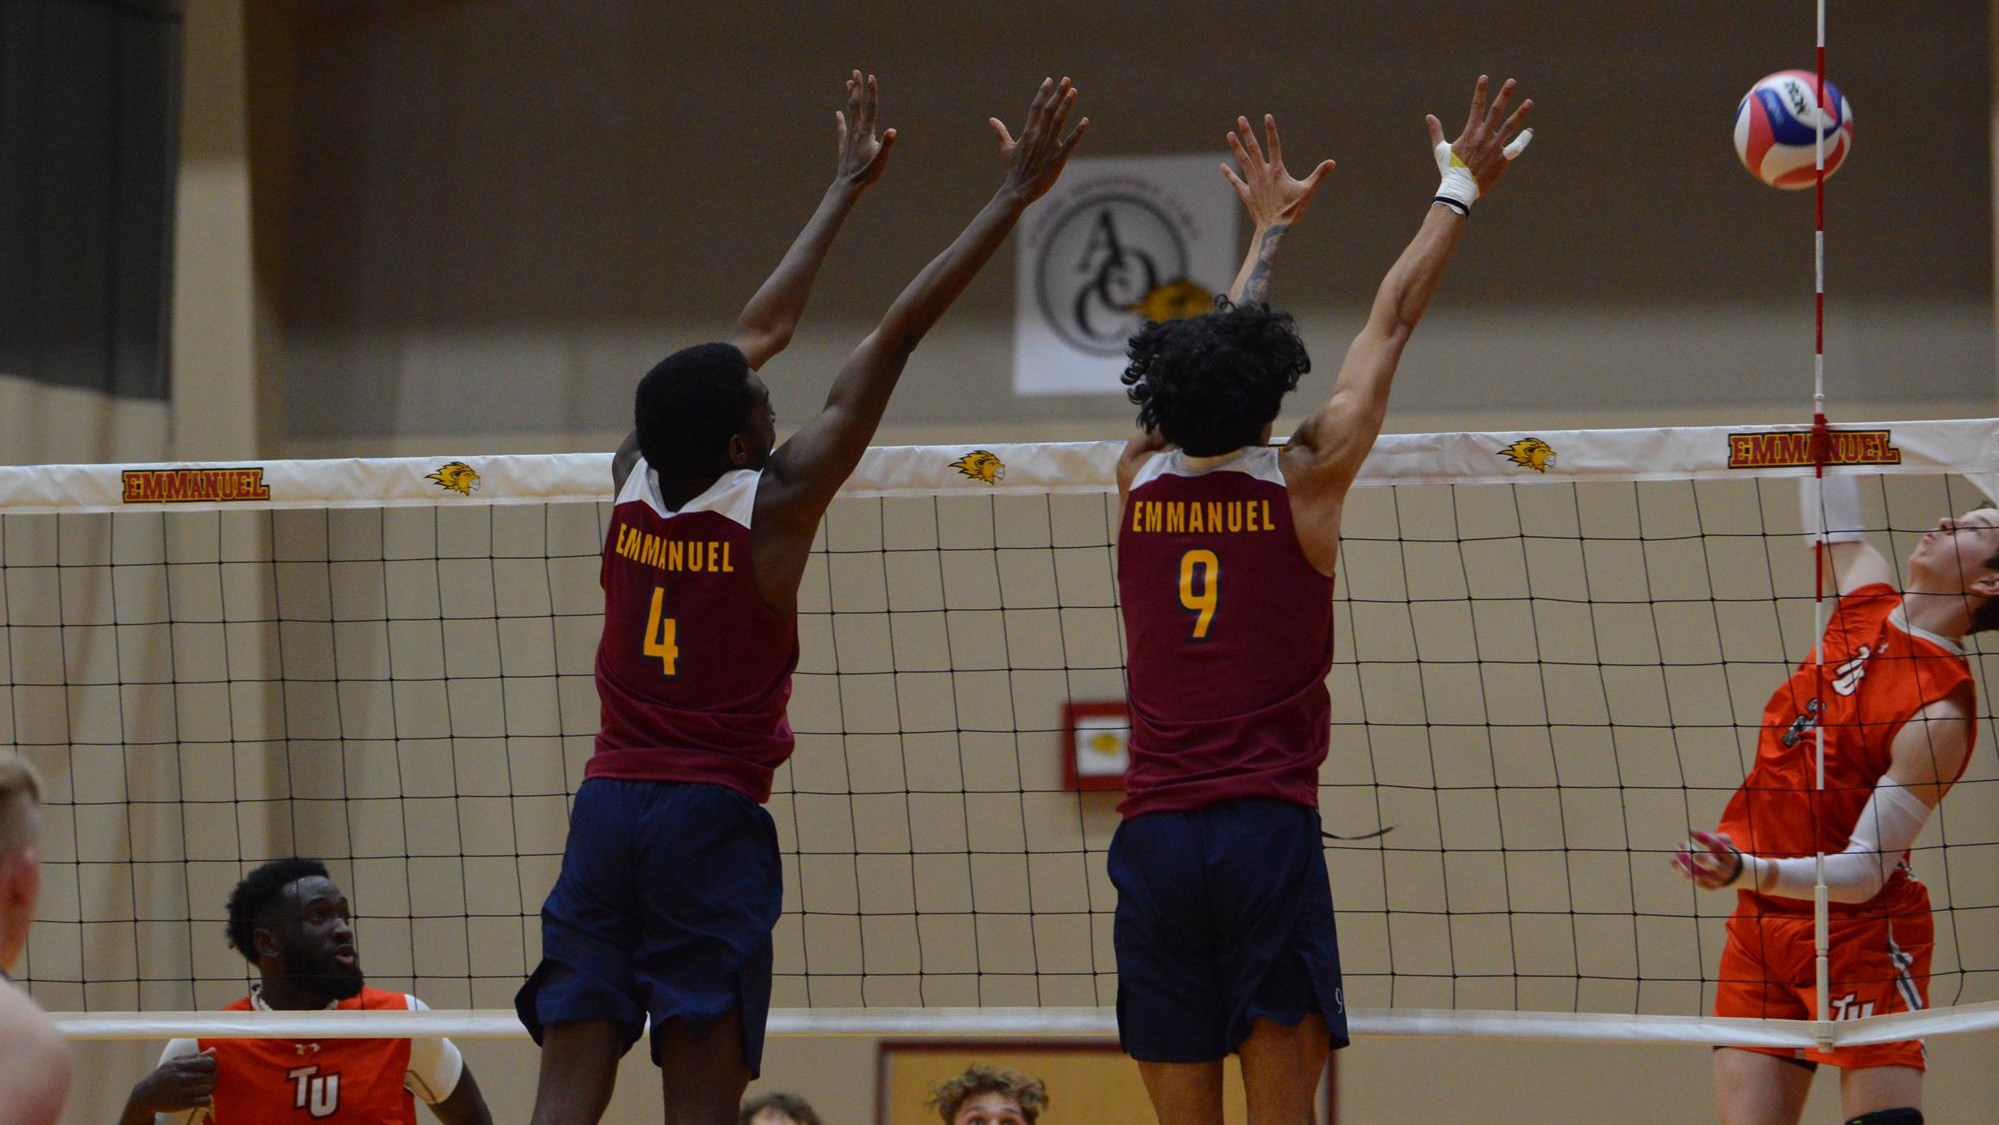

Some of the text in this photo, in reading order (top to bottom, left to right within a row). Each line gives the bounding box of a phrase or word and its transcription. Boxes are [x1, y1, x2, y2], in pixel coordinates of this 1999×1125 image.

[123, 469, 270, 502] EMMANUEL
[1132, 500, 1275, 533] EMMANUEL
[615, 523, 734, 573] EMMANUEL
[1179, 549, 1219, 638] 9
[643, 586, 679, 676] 4
[288, 1066, 339, 1117] TU
